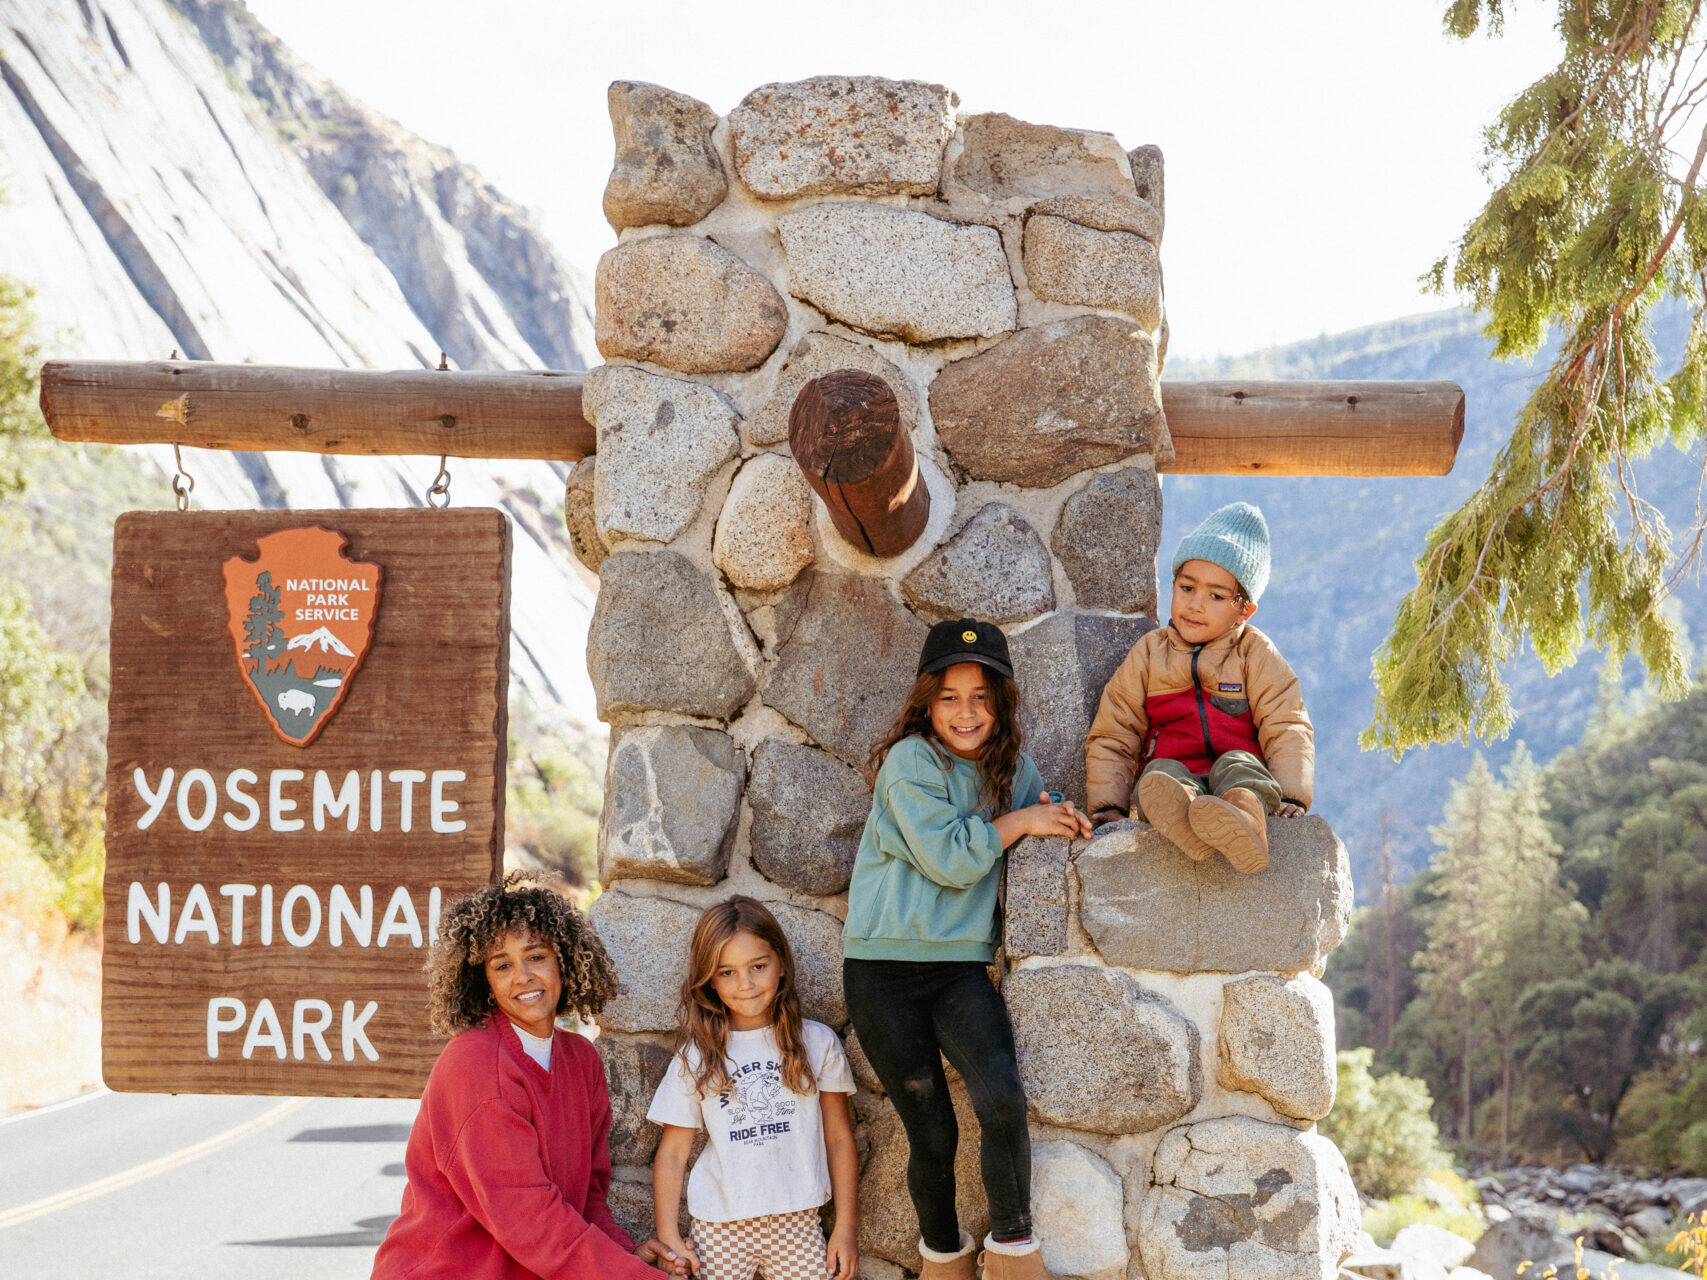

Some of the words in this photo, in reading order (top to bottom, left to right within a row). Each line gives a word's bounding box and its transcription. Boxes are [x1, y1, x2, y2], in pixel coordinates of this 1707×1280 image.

[286, 579, 370, 592] NATIONAL
[306, 593, 349, 606] PARK
[295, 608, 359, 621] SERVICE
[133, 767, 467, 834] YOSEMITE
[206, 997, 380, 1062] PARK
[775, 1100, 796, 1109] GOOD
[729, 1126, 758, 1142] RIDE
[760, 1121, 791, 1136] FREE
